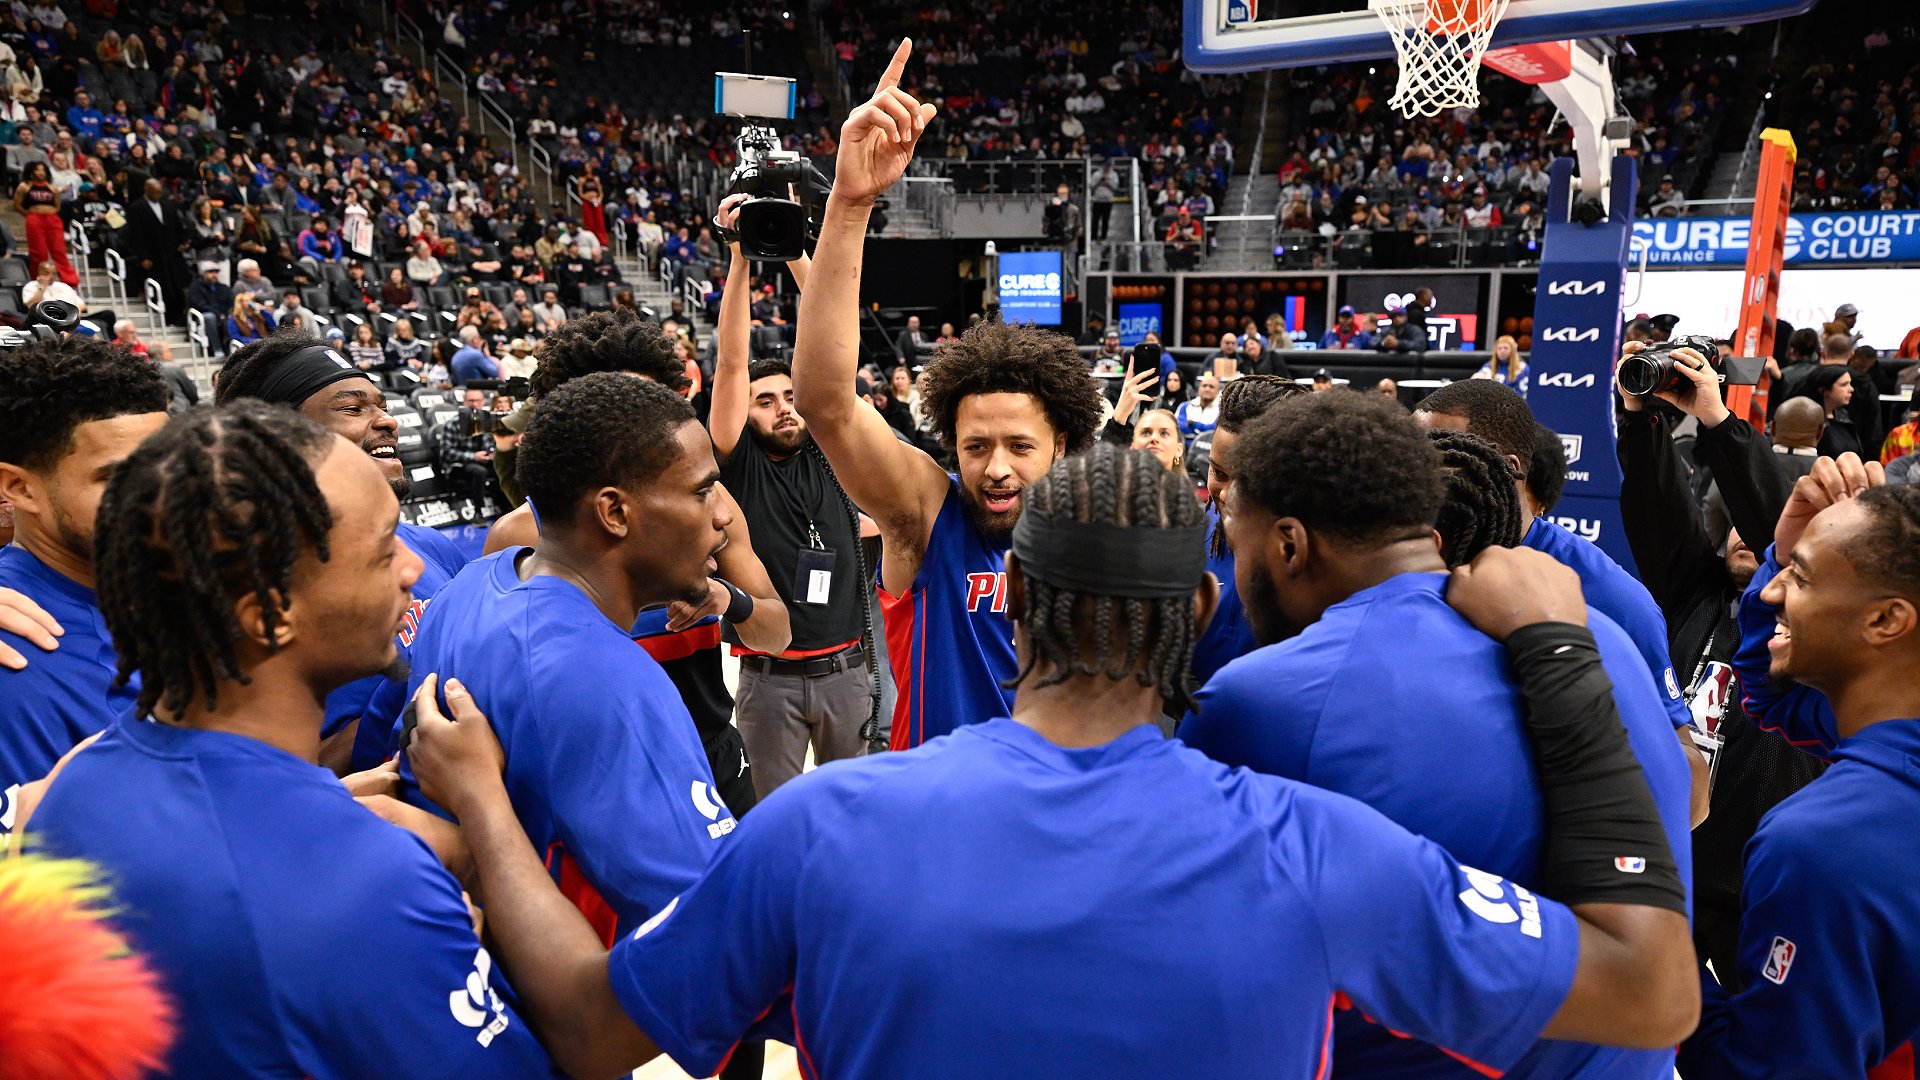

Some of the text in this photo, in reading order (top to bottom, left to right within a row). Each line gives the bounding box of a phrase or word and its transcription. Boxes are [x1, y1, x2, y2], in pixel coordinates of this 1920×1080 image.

[1230, 7, 1246, 20] NBA
[1629, 220, 1751, 251] CURE
[1628, 250, 1716, 263] NURANCE
[1809, 237, 1892, 260] CLUB
[999, 273, 1046, 290] CURE
[1119, 316, 1149, 335] CURE
[966, 571, 1008, 614] PI
